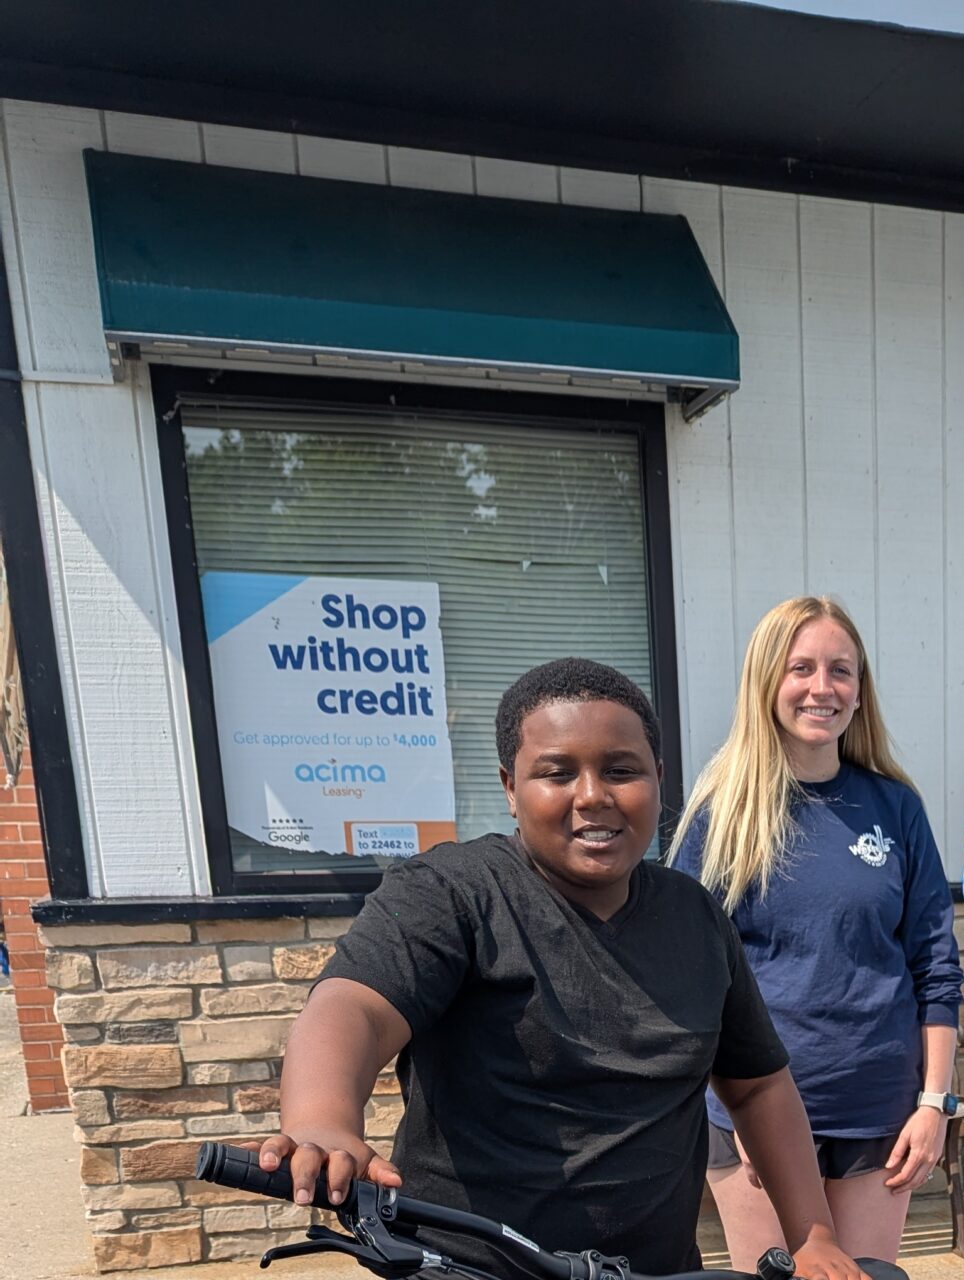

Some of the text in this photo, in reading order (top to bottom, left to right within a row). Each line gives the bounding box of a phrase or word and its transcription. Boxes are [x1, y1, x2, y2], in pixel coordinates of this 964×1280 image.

[321, 594, 426, 639] Shop
[268, 636, 430, 674] without
[317, 682, 434, 716] credit
[233, 731, 436, 748] Get approved for up to $4,000
[295, 759, 386, 783] acima
[268, 831, 310, 845] Google
[358, 829, 378, 839] Text
[358, 840, 415, 850] to 22462 to
